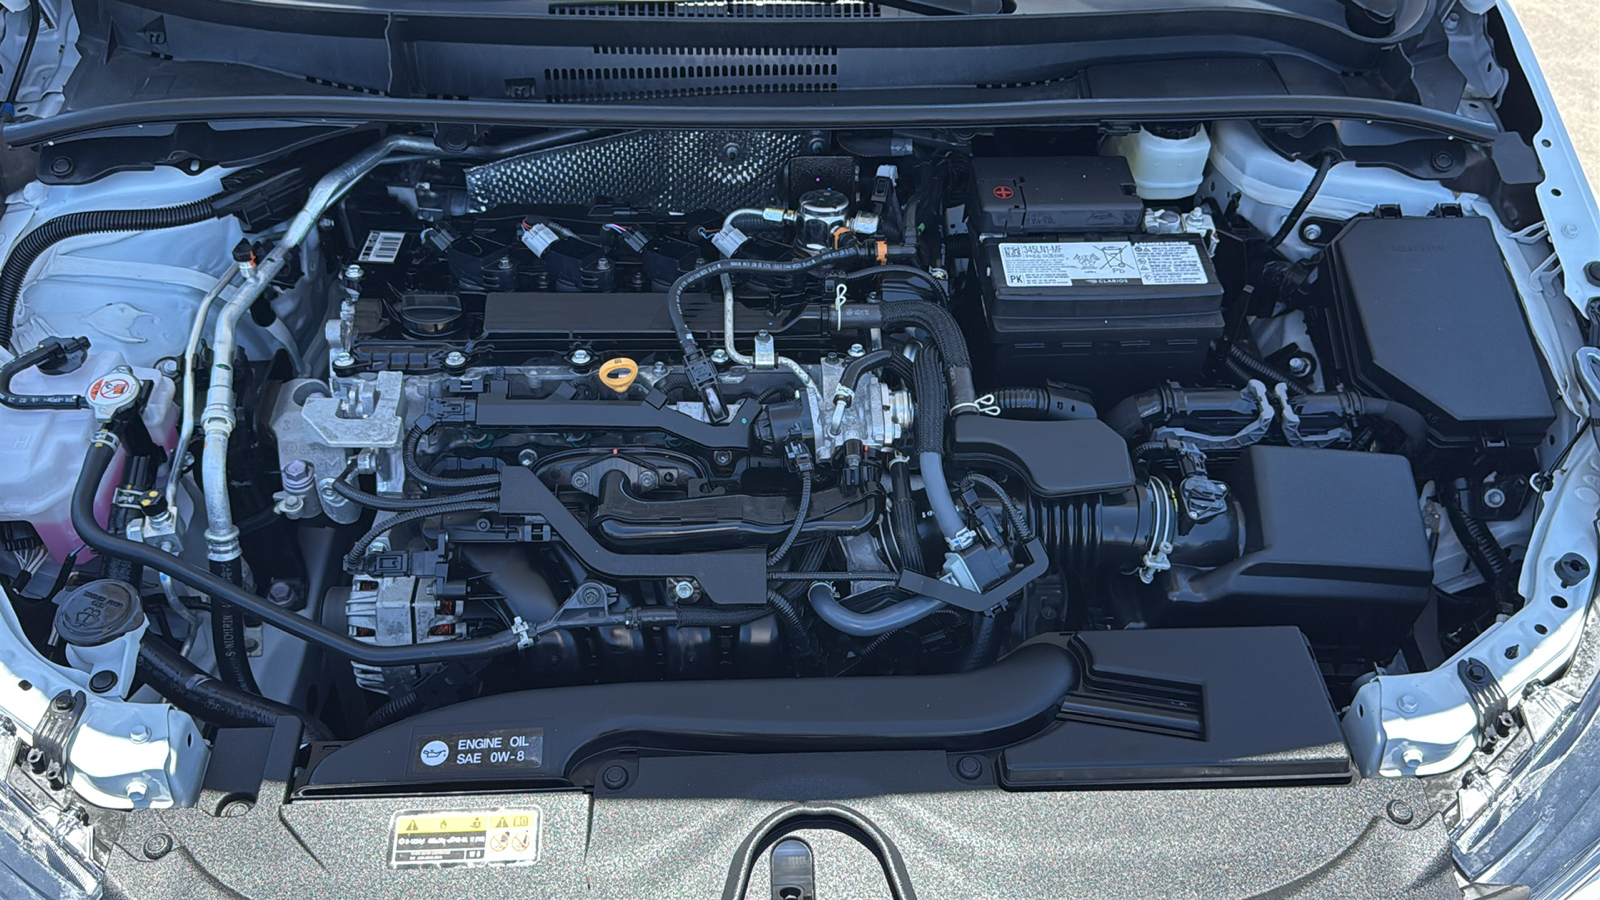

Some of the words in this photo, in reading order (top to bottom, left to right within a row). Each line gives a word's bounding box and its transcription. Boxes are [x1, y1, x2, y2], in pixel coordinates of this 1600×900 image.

[1010, 275, 1023, 284] PK
[458, 737, 502, 750] ENGINE
[510, 736, 529, 747] OIL
[456, 753, 482, 765] SAE
[490, 750, 525, 763] 0W-8
